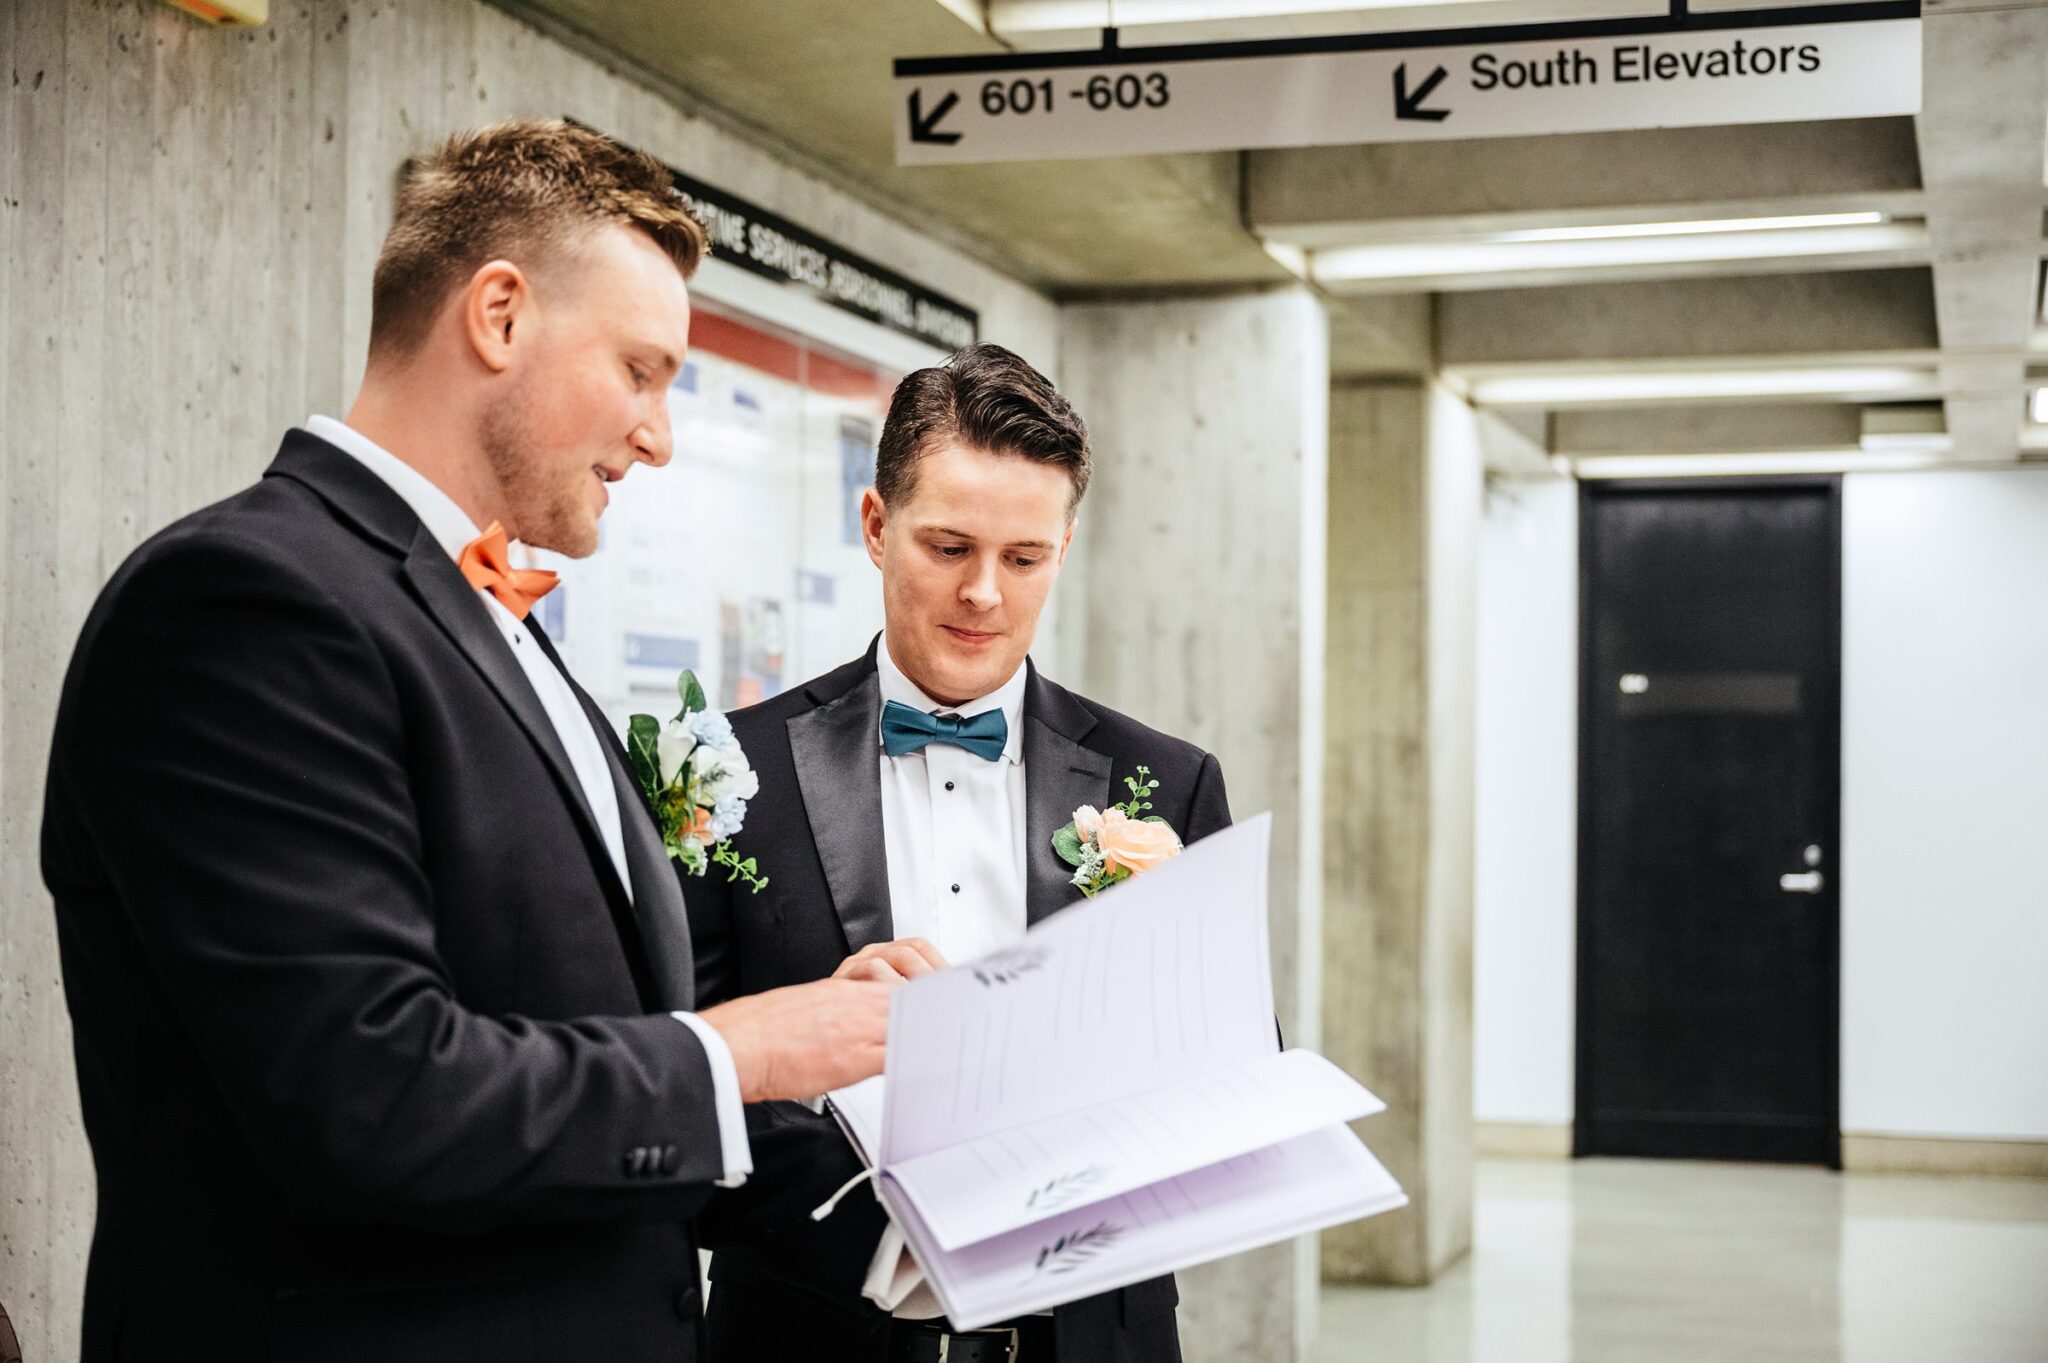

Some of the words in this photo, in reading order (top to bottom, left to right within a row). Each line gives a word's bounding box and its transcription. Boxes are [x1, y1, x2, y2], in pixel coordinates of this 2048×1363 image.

[1470, 49, 1598, 91] South
[1612, 40, 1821, 84] Elevators
[980, 77, 1055, 117] 601
[749, 223, 828, 290] SERVICES
